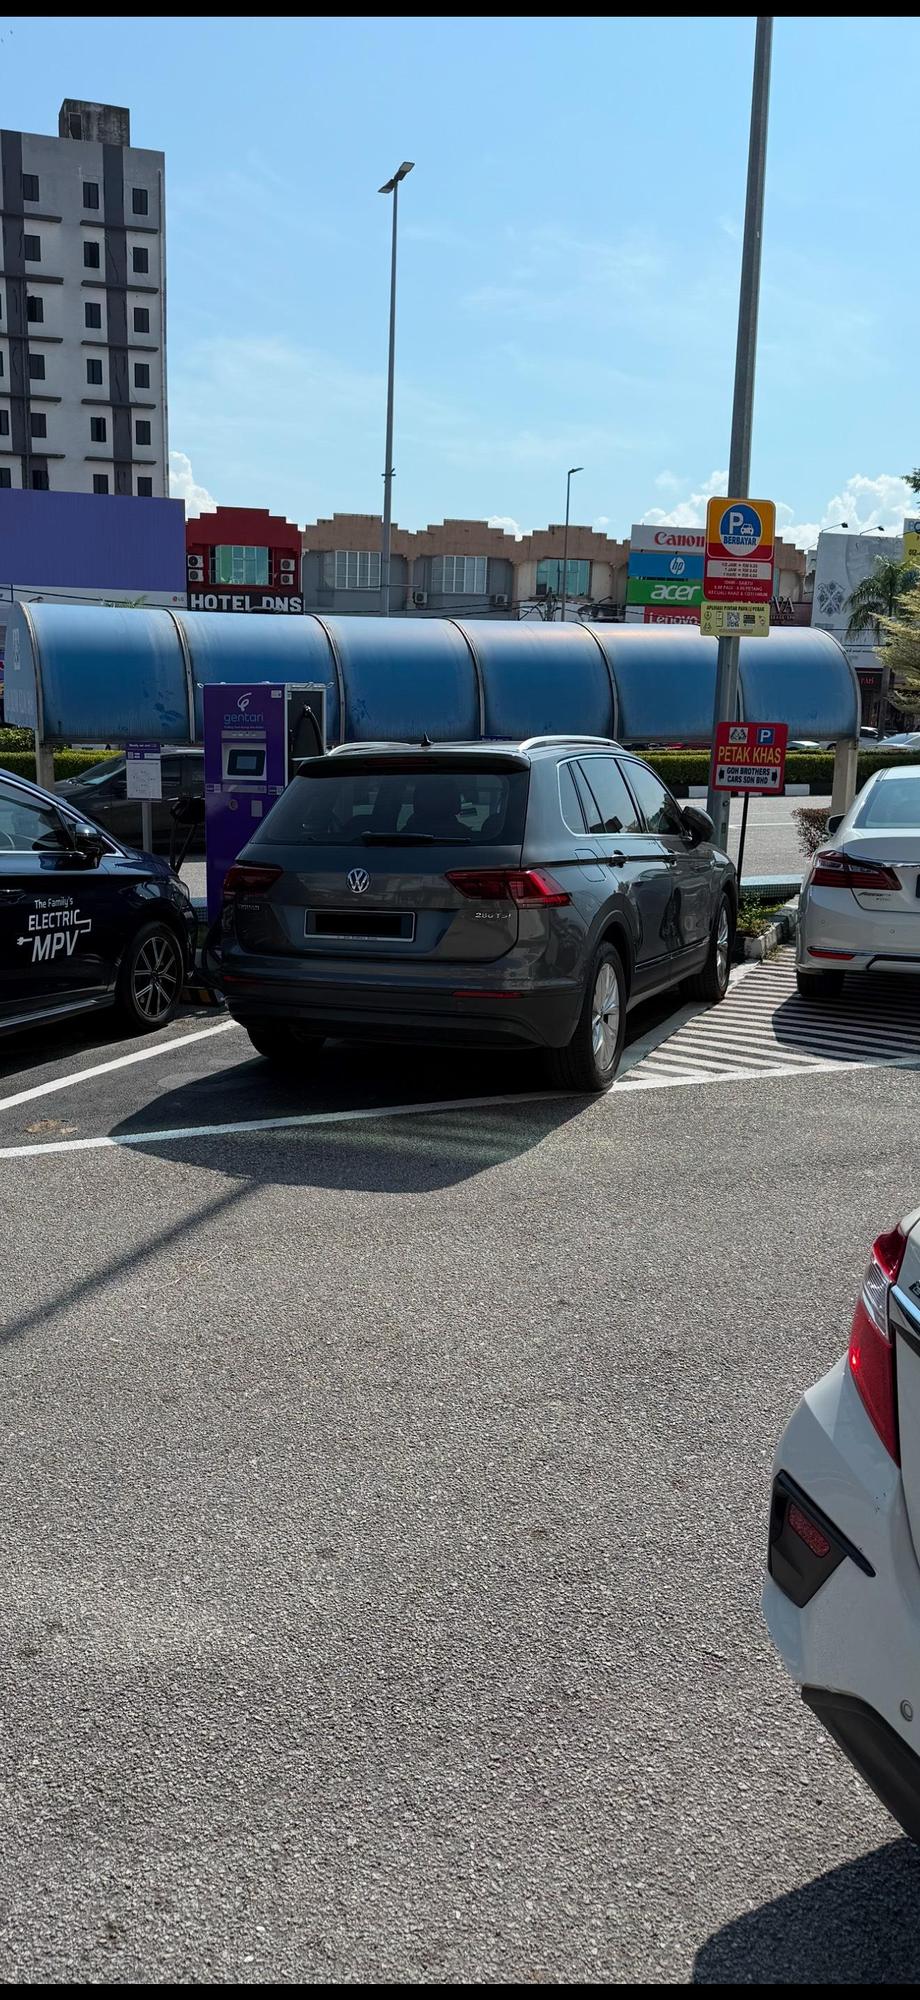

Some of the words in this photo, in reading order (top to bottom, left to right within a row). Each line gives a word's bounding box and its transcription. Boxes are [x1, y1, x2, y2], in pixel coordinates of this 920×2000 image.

[729, 511, 744, 535] P
[654, 531, 705, 547] Canon
[723, 535, 757, 546] BERBAYAR
[670, 557, 685, 575] hp
[650, 584, 701, 600] acer
[191, 593, 250, 612] HOTEL
[261, 595, 302, 613] DNS
[649, 612, 700, 625] Lenovo
[223, 712, 264, 725] gentari
[759, 729, 772, 742] P
[717, 745, 751, 764] PETAK
[751, 746, 782, 764] KHAS
[726, 766, 739, 776] GOH
[739, 767, 770, 777] BROTHERS
[727, 775, 742, 783] CARS
[743, 775, 755, 784] SDN
[756, 776, 769, 785] BHD
[34, 898, 47, 909] The
[47, 896, 74, 908] Family's
[28, 909, 84, 931] ELECTRIC
[31, 930, 79, 963] MPV
